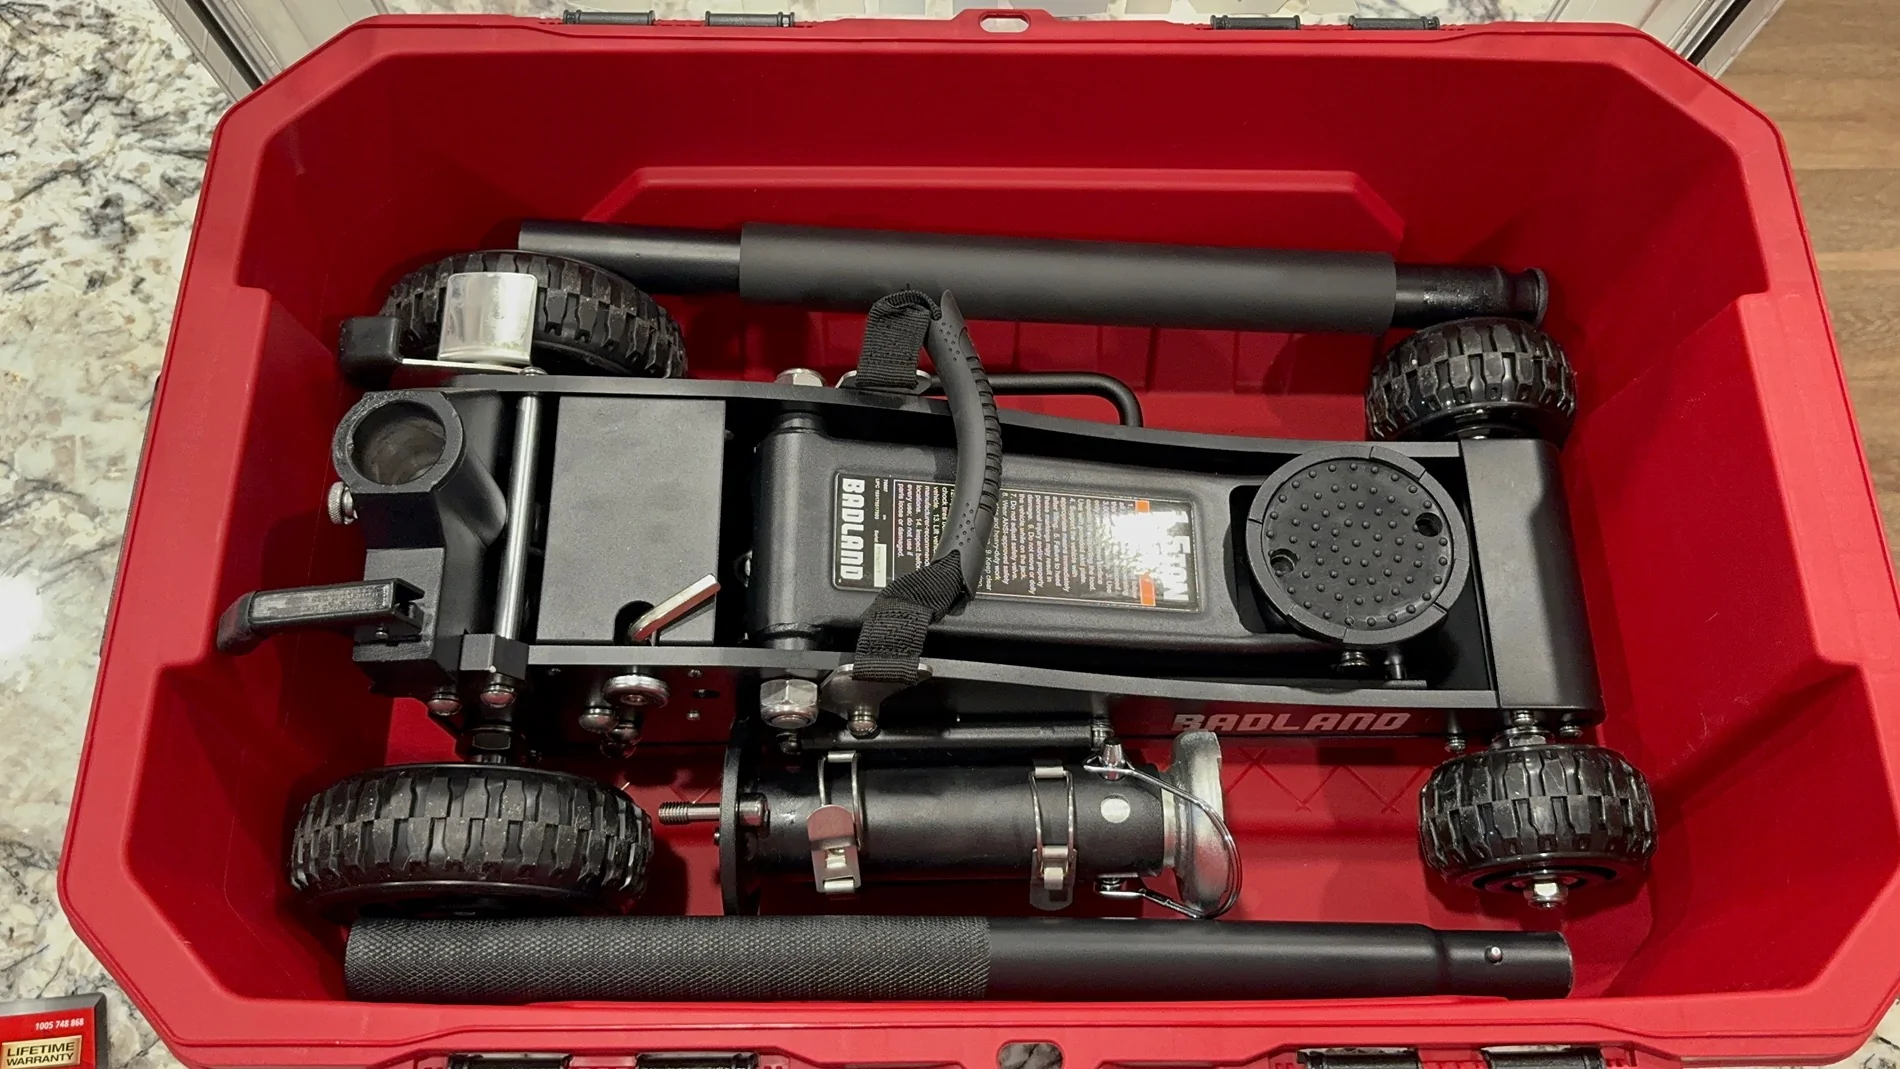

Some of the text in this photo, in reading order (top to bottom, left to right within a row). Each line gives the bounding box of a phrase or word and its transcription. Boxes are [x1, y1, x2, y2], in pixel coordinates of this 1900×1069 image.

[1011, 501, 1016, 509] Do
[907, 518, 913, 526] do
[841, 478, 865, 580] BADLAND
[1028, 532, 1034, 540] Do
[1171, 712, 1411, 732] BADLAND
[36, 1018, 84, 1030] 1005 748 868
[7, 1042, 76, 1057] LIFETIME
[6, 1053, 74, 1066] WARRANTY
